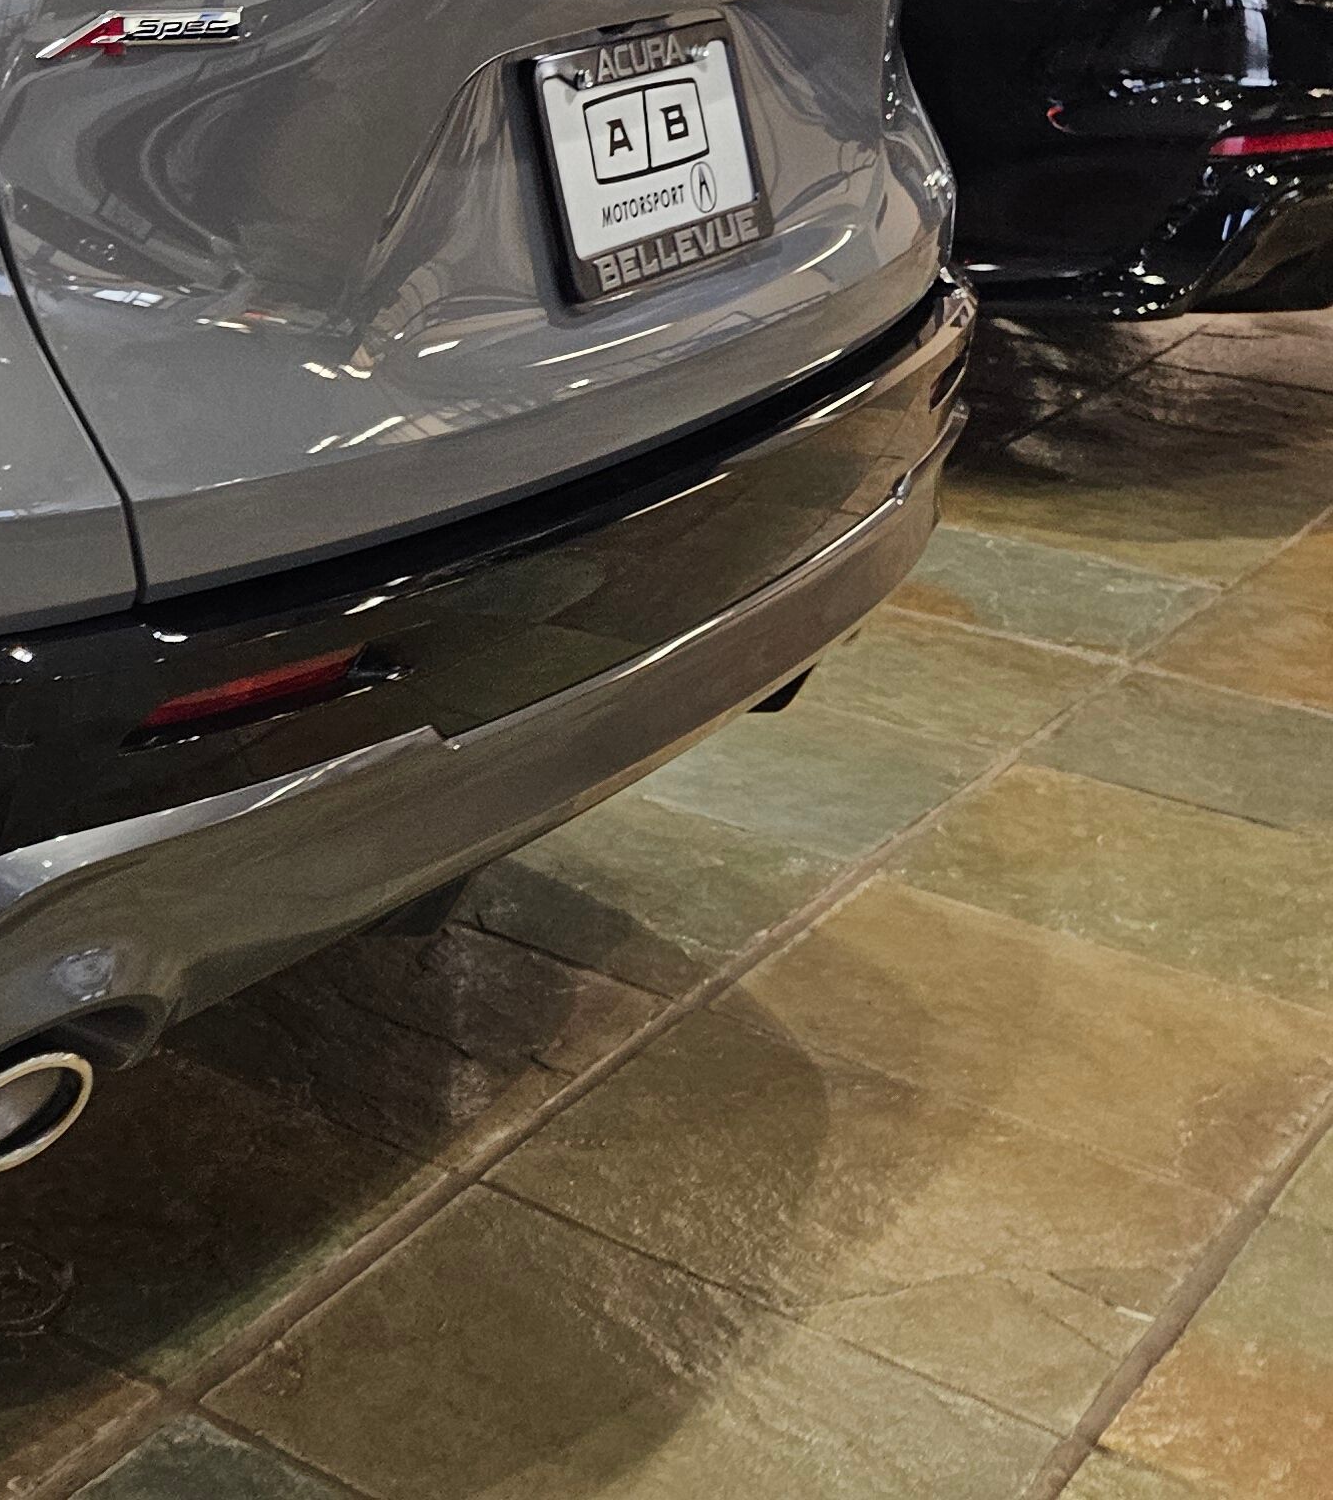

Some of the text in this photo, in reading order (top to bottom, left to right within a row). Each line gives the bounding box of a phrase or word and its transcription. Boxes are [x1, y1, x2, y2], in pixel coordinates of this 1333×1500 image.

[598, 34, 686, 82] ACURA
[606, 103, 689, 157] A B
[602, 184, 685, 228] MOTORSPORT
[592, 208, 760, 292] BELLEVUE
